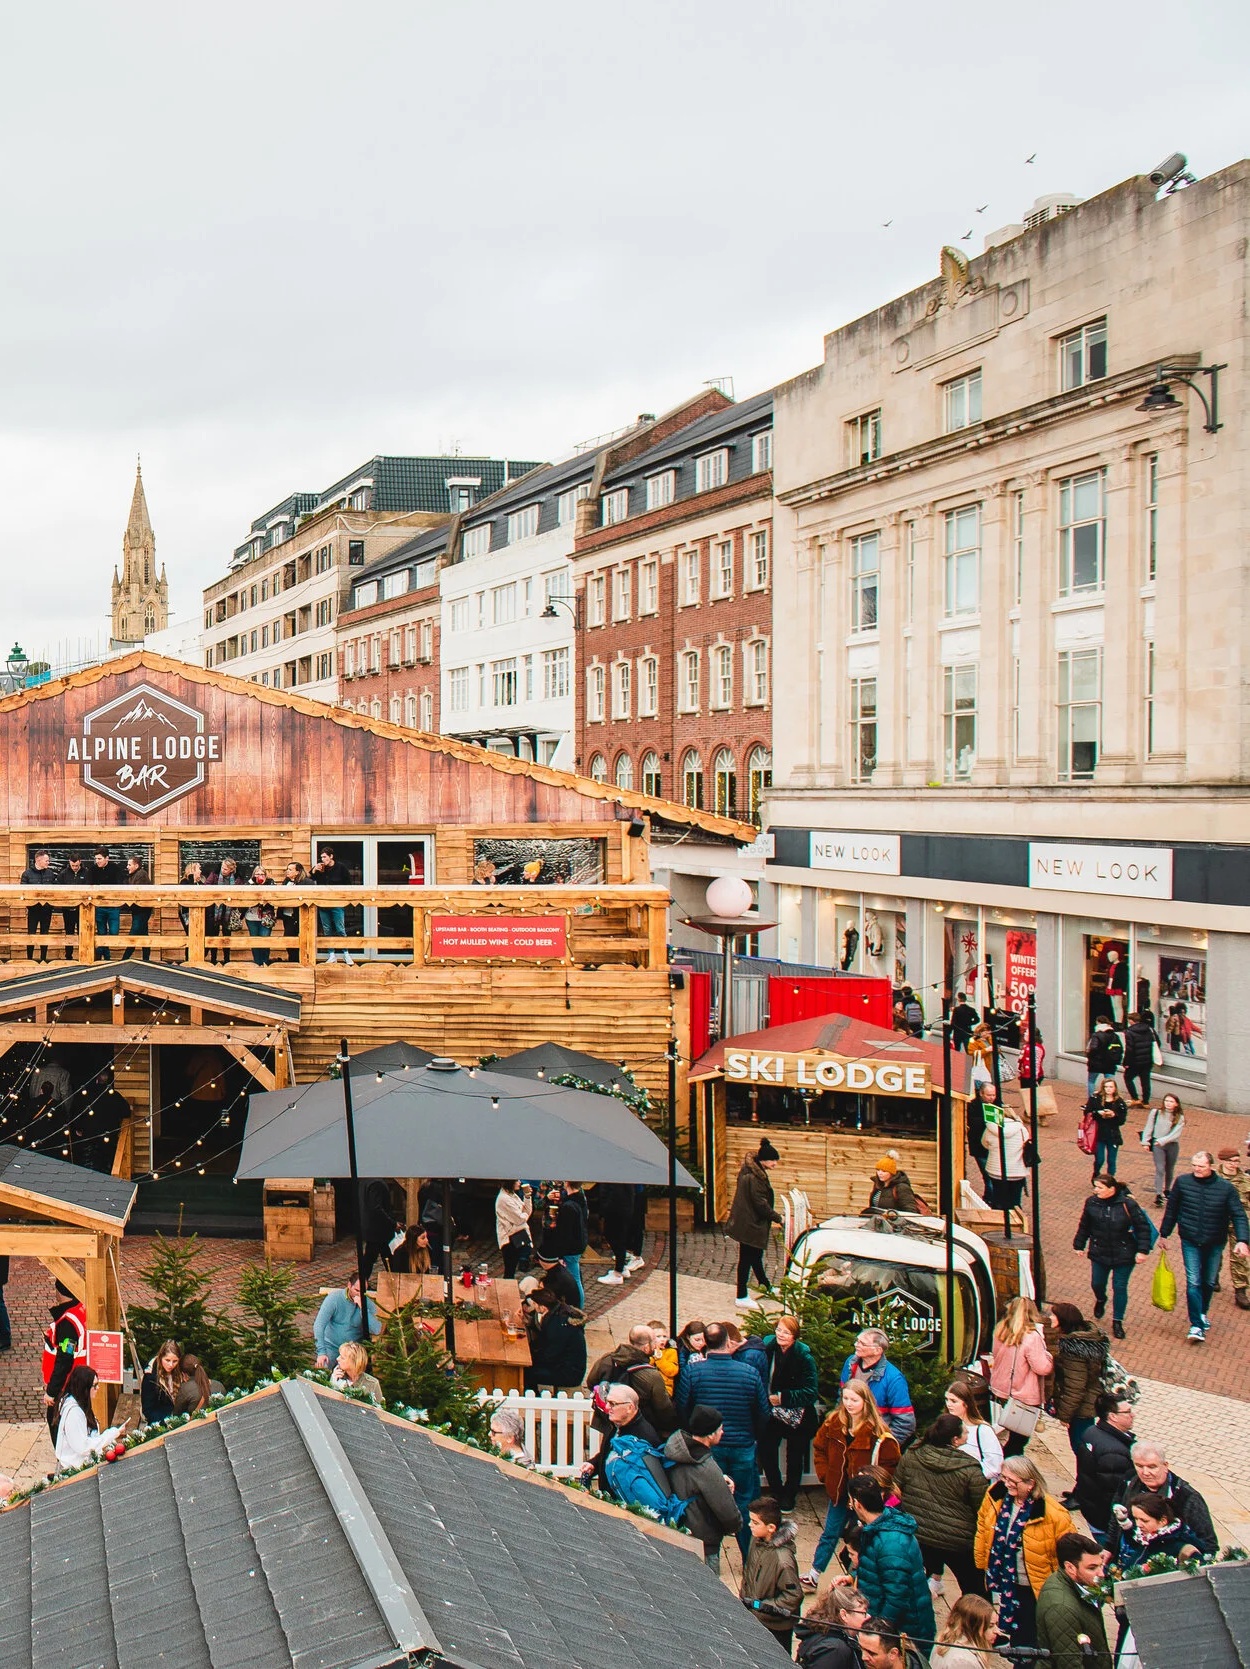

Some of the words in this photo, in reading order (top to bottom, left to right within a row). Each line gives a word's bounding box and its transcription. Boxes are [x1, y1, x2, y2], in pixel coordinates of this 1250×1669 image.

[67, 736, 142, 761] ALPINE
[152, 735, 219, 760] LODGE
[115, 763, 171, 791] BAR
[815, 844, 845, 859] NEW
[852, 846, 891, 862] LOOK
[1036, 858, 1084, 876] NEW
[1096, 861, 1158, 882] LOOK
[443, 938, 459, 946] HOT
[460, 938, 488, 946] MULLED
[488, 938, 509, 946] WINE
[513, 938, 535, 946] COLD
[535, 938, 553, 946] BEER
[1010, 953, 1037, 966] WINTE
[727, 1053, 785, 1083] SKI
[797, 1058, 926, 1094] LODGE
[903, 1316, 942, 1332] LODGE
